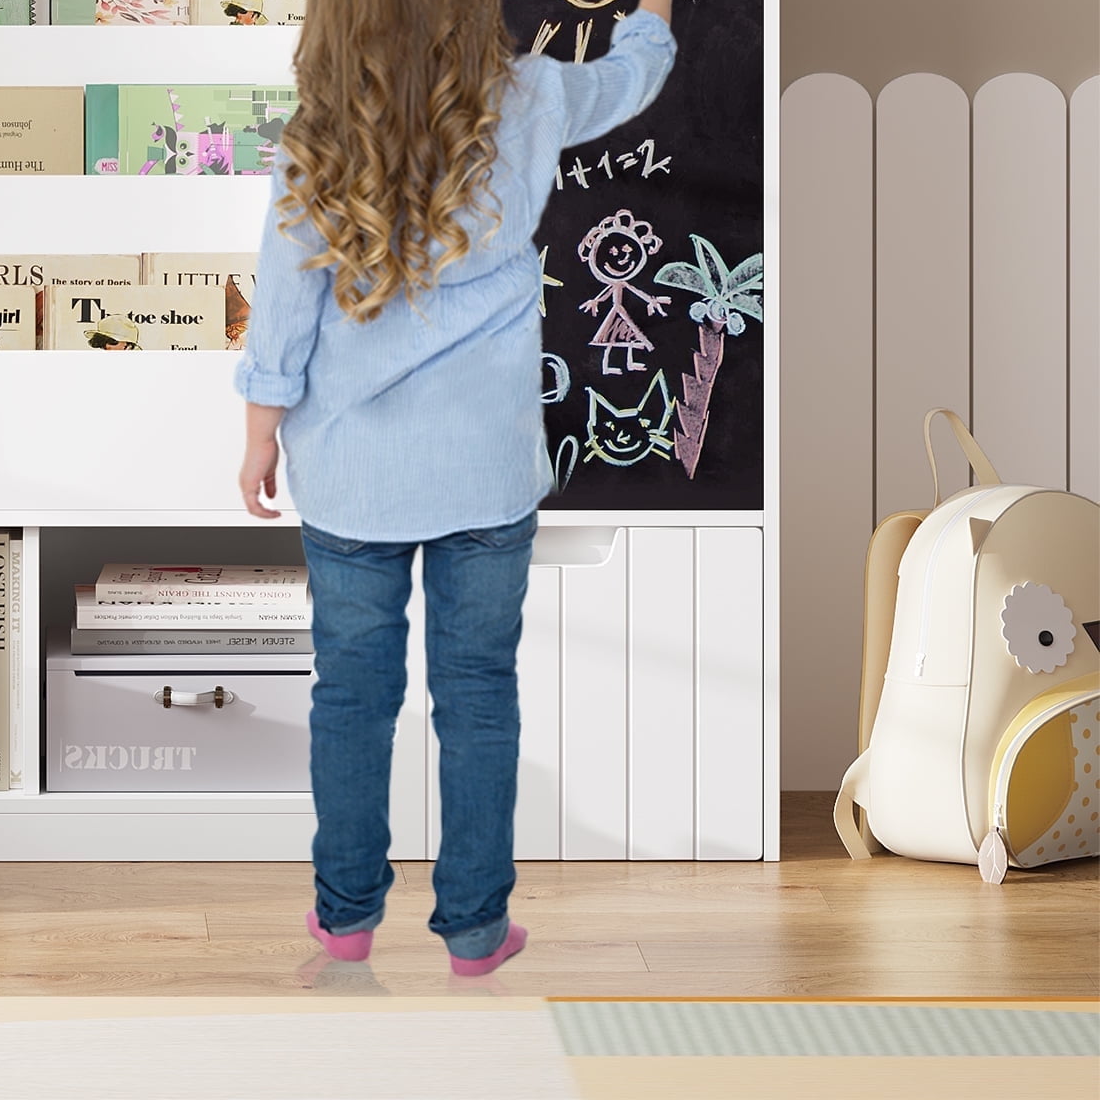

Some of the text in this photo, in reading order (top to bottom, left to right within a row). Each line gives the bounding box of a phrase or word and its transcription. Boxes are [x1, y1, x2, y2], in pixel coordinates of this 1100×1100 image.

[1, 120, 32, 130] Johnson
[24, 160, 45, 172] The
[51, 277, 132, 287] The story of Doris
[129, 309, 204, 325] toe shoe
[11, 551, 20, 613] MAKING
[157, 590, 292, 599] GOING AGAINST THE GRAIN
[258, 613, 279, 621] KHAN
[11, 617, 20, 634] IT
